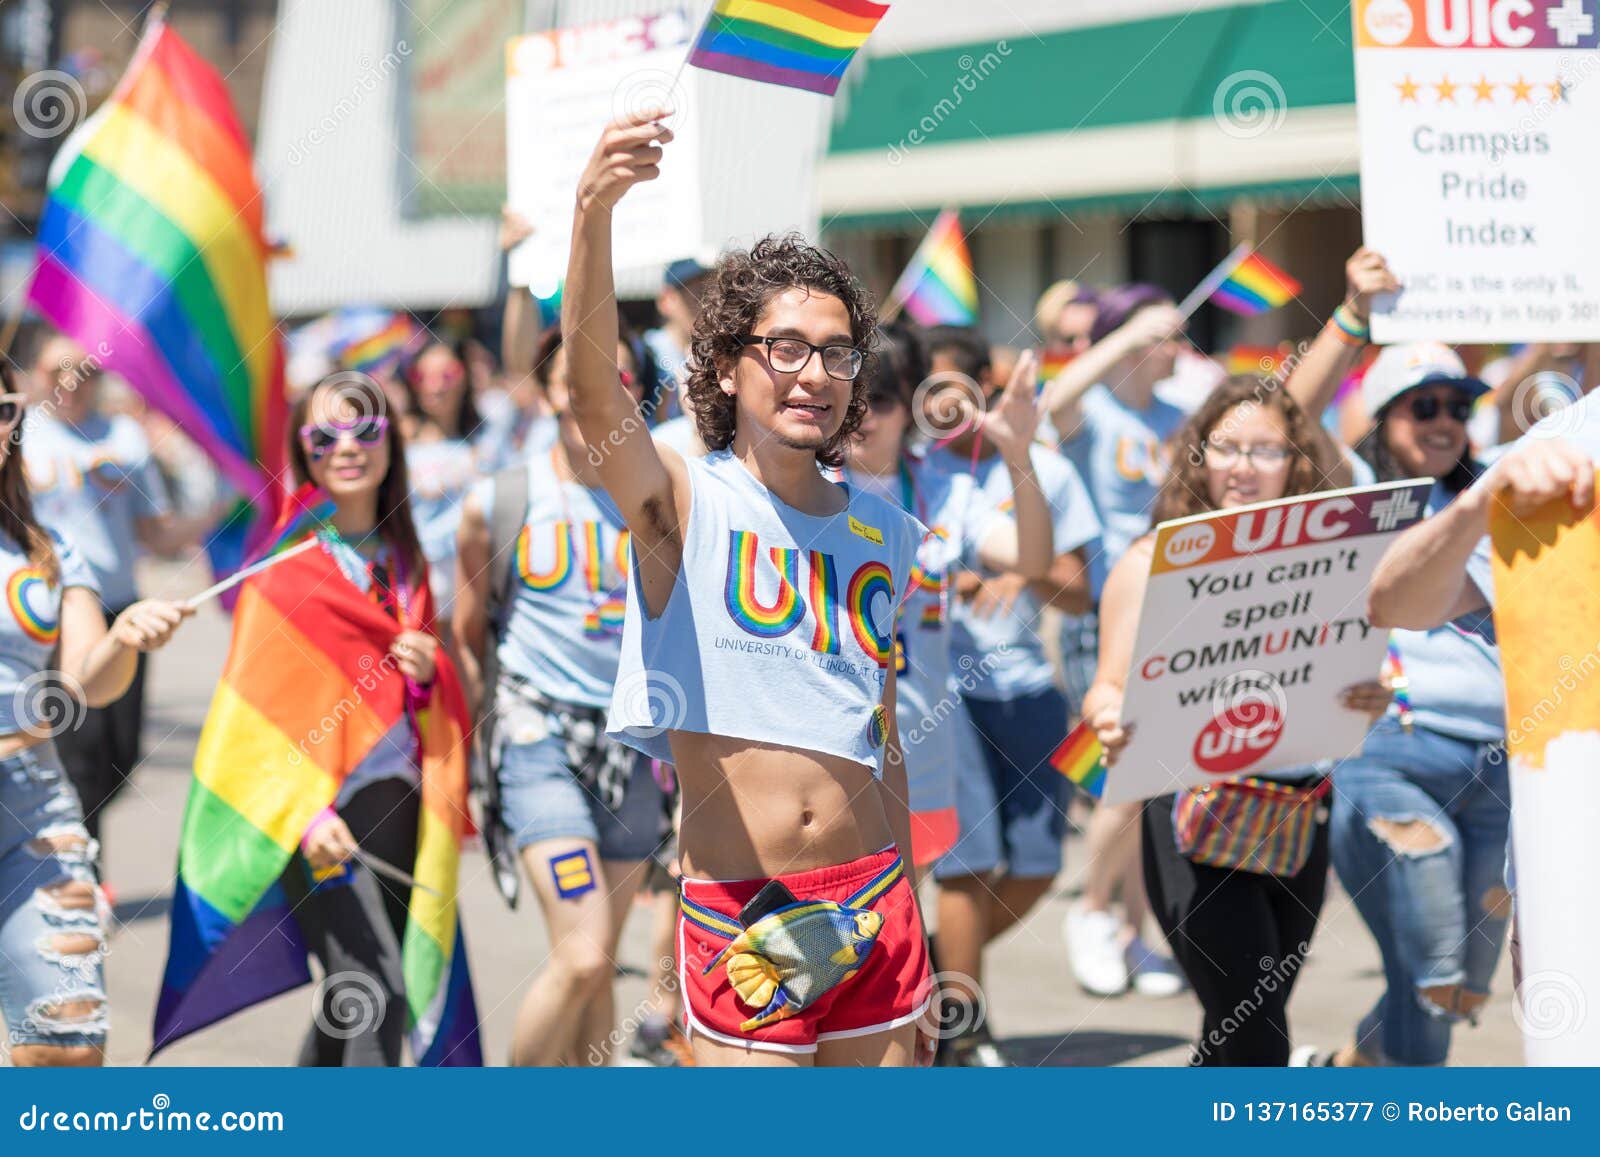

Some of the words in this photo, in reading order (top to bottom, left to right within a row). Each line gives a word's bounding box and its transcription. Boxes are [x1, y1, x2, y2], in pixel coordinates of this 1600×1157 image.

[1425, 0, 1536, 47] UIC
[1412, 124, 1551, 162] Campus
[1440, 171, 1527, 200] Pride
[1446, 218, 1537, 246] Index
[1471, 273, 1505, 292] the
[1232, 499, 1351, 553] UIC
[512, 519, 630, 595] UI
[1170, 536, 1211, 556] UIC
[724, 529, 895, 669] UIC
[1187, 571, 1253, 599] You
[1224, 592, 1313, 630] spell
[714, 636, 792, 661] UNIVERSITY
[1141, 617, 1372, 681] COMMUNITY
[1178, 661, 1313, 708] without
[1199, 721, 1276, 759] UIC
